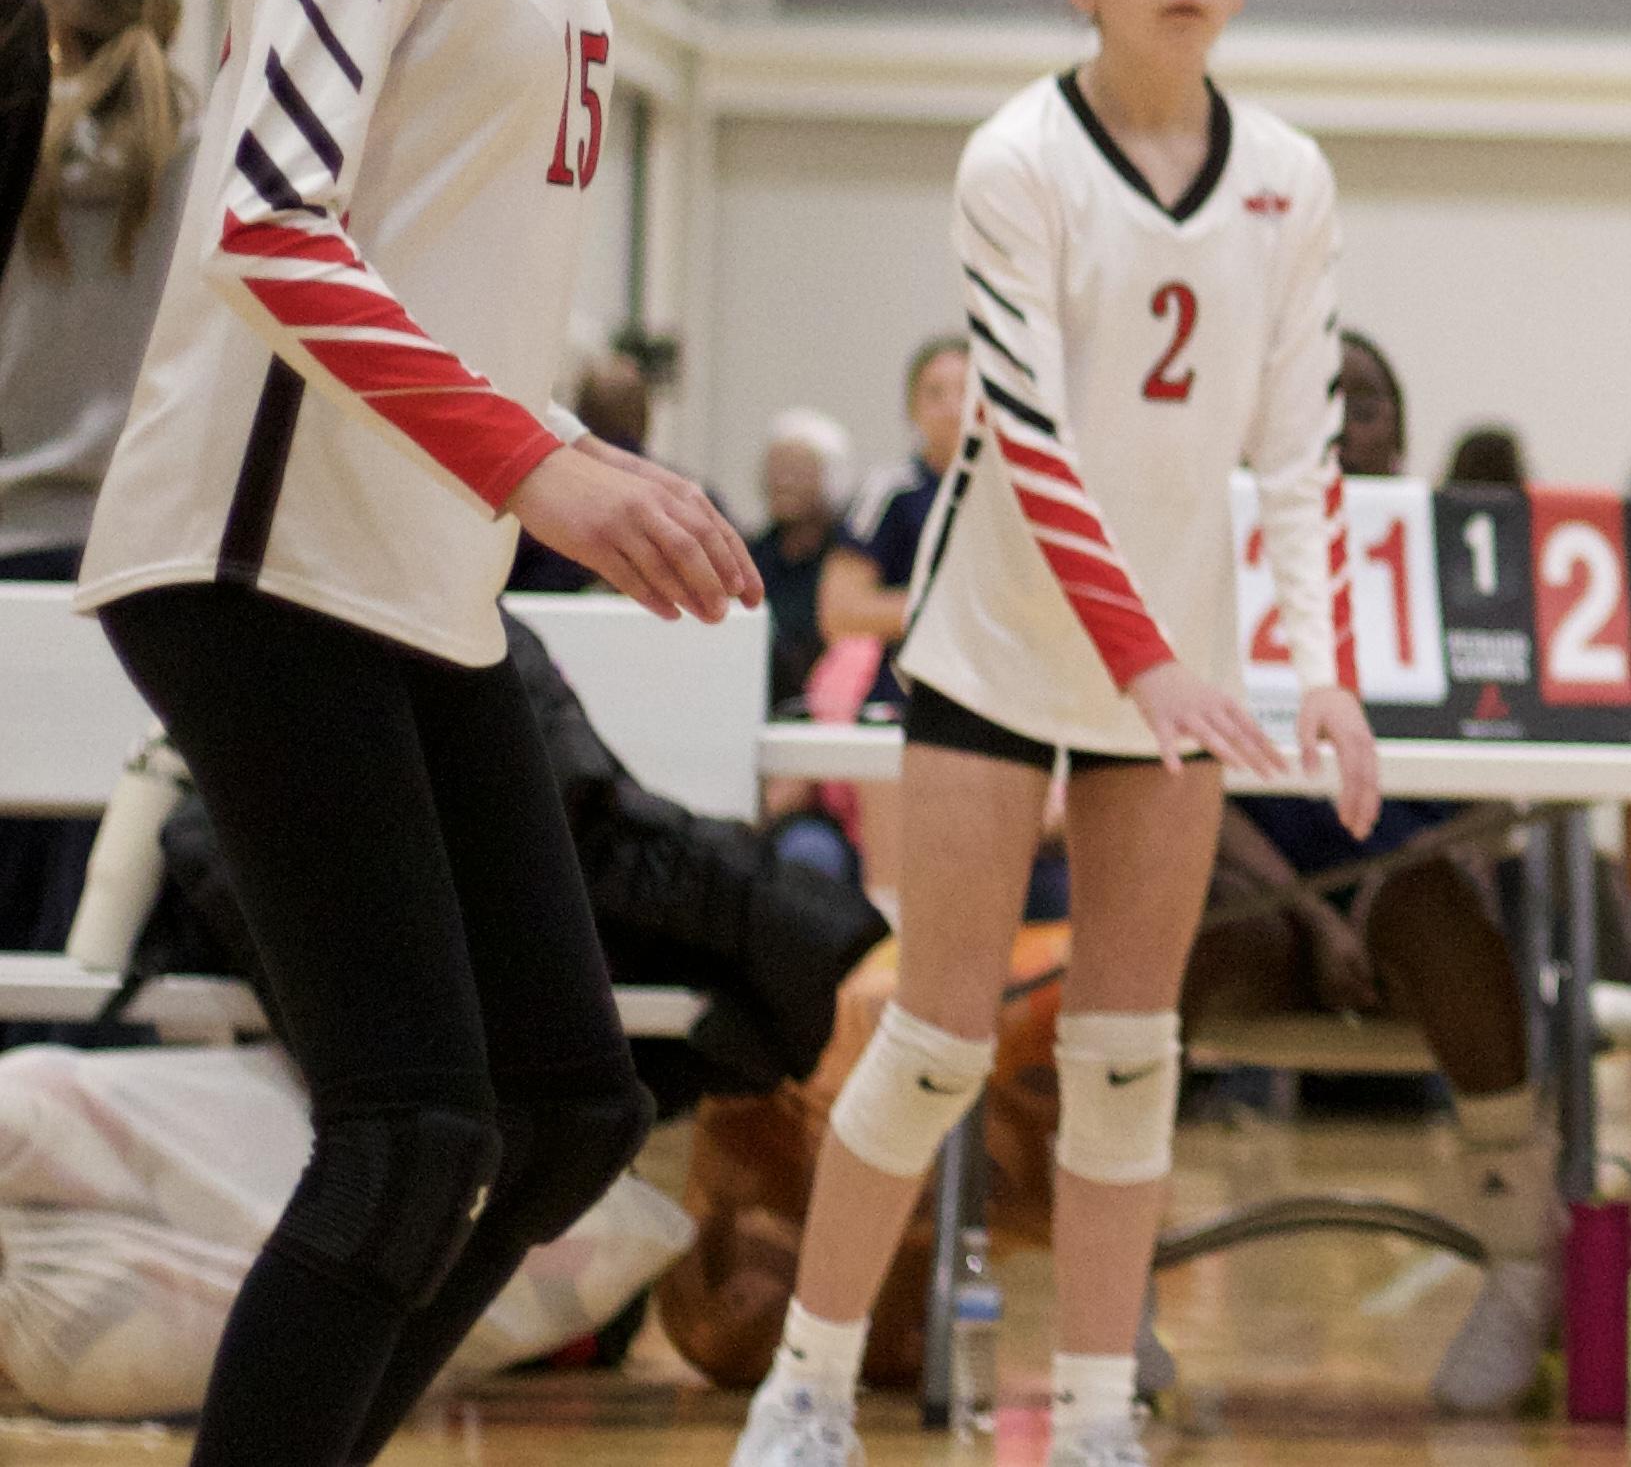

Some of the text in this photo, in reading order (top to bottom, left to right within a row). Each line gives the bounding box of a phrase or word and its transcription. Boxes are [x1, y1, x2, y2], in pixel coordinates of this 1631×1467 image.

[546, 20, 609, 191] 15
[1143, 281, 1197, 401] 2
[1464, 513, 1498, 597] 1
